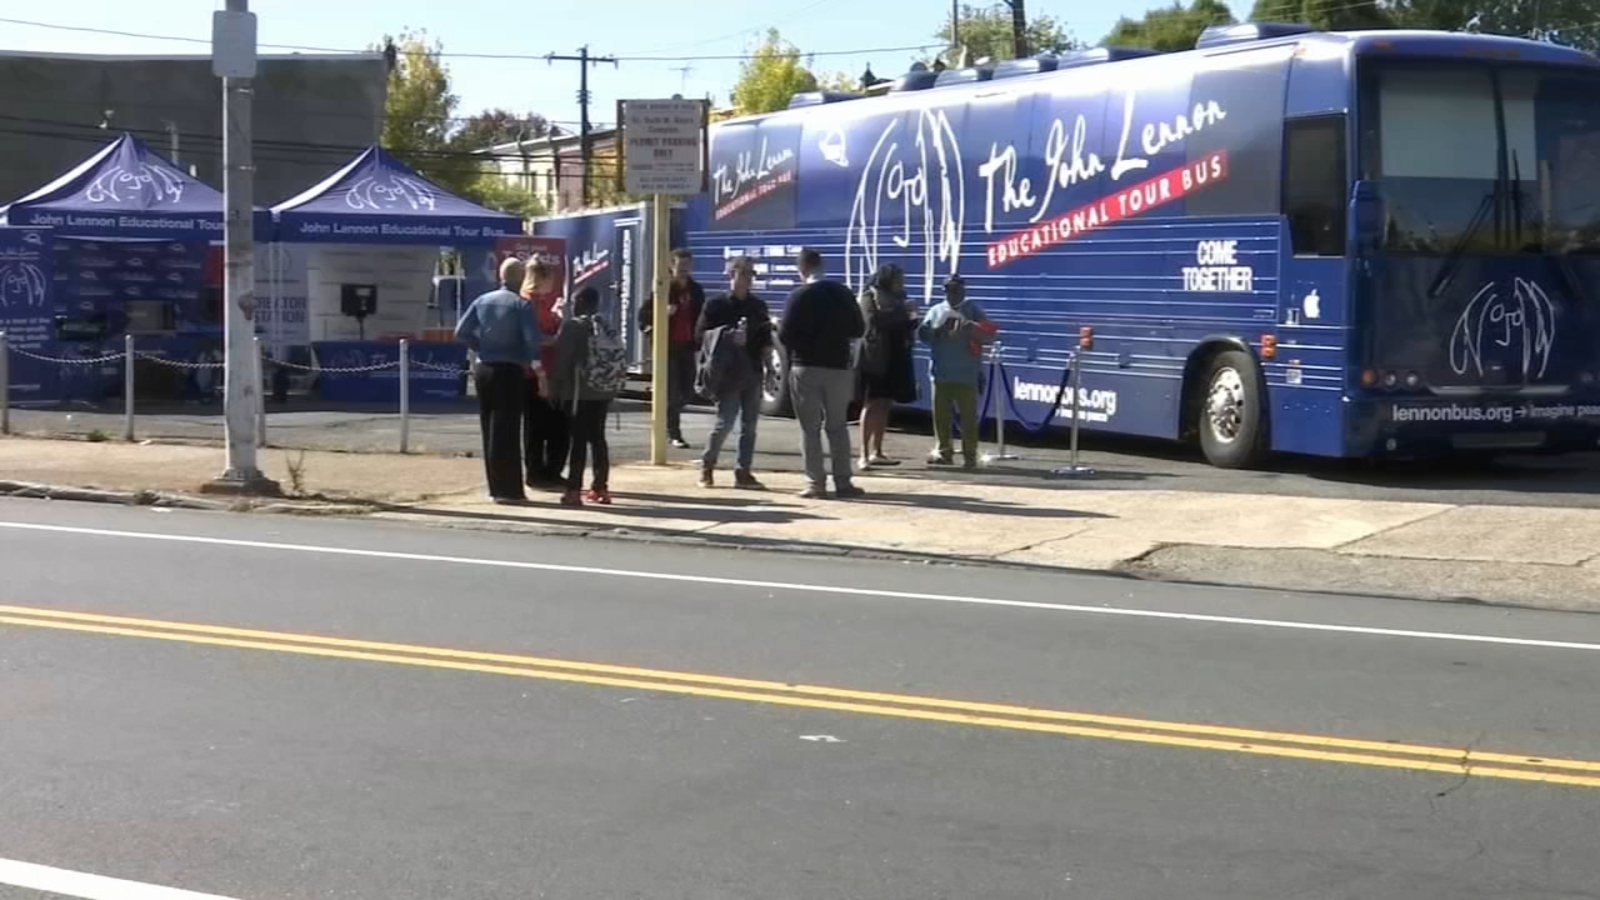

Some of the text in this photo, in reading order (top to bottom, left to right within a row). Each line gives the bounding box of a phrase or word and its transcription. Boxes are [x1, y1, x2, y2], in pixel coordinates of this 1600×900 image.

[979, 89, 1226, 233] The John Lennon
[30, 213, 226, 230] John Lennon Educational Tour
[988, 155, 1222, 267] EDUCATIONAL TOUR BUS
[299, 222, 505, 237] John Lennon Educational Tour Bus
[1196, 240, 1238, 265] COME
[1181, 266, 1253, 291] TOGETHER
[1392, 403, 1513, 423] lennonbus.org
[1529, 404, 1576, 419] imagine
